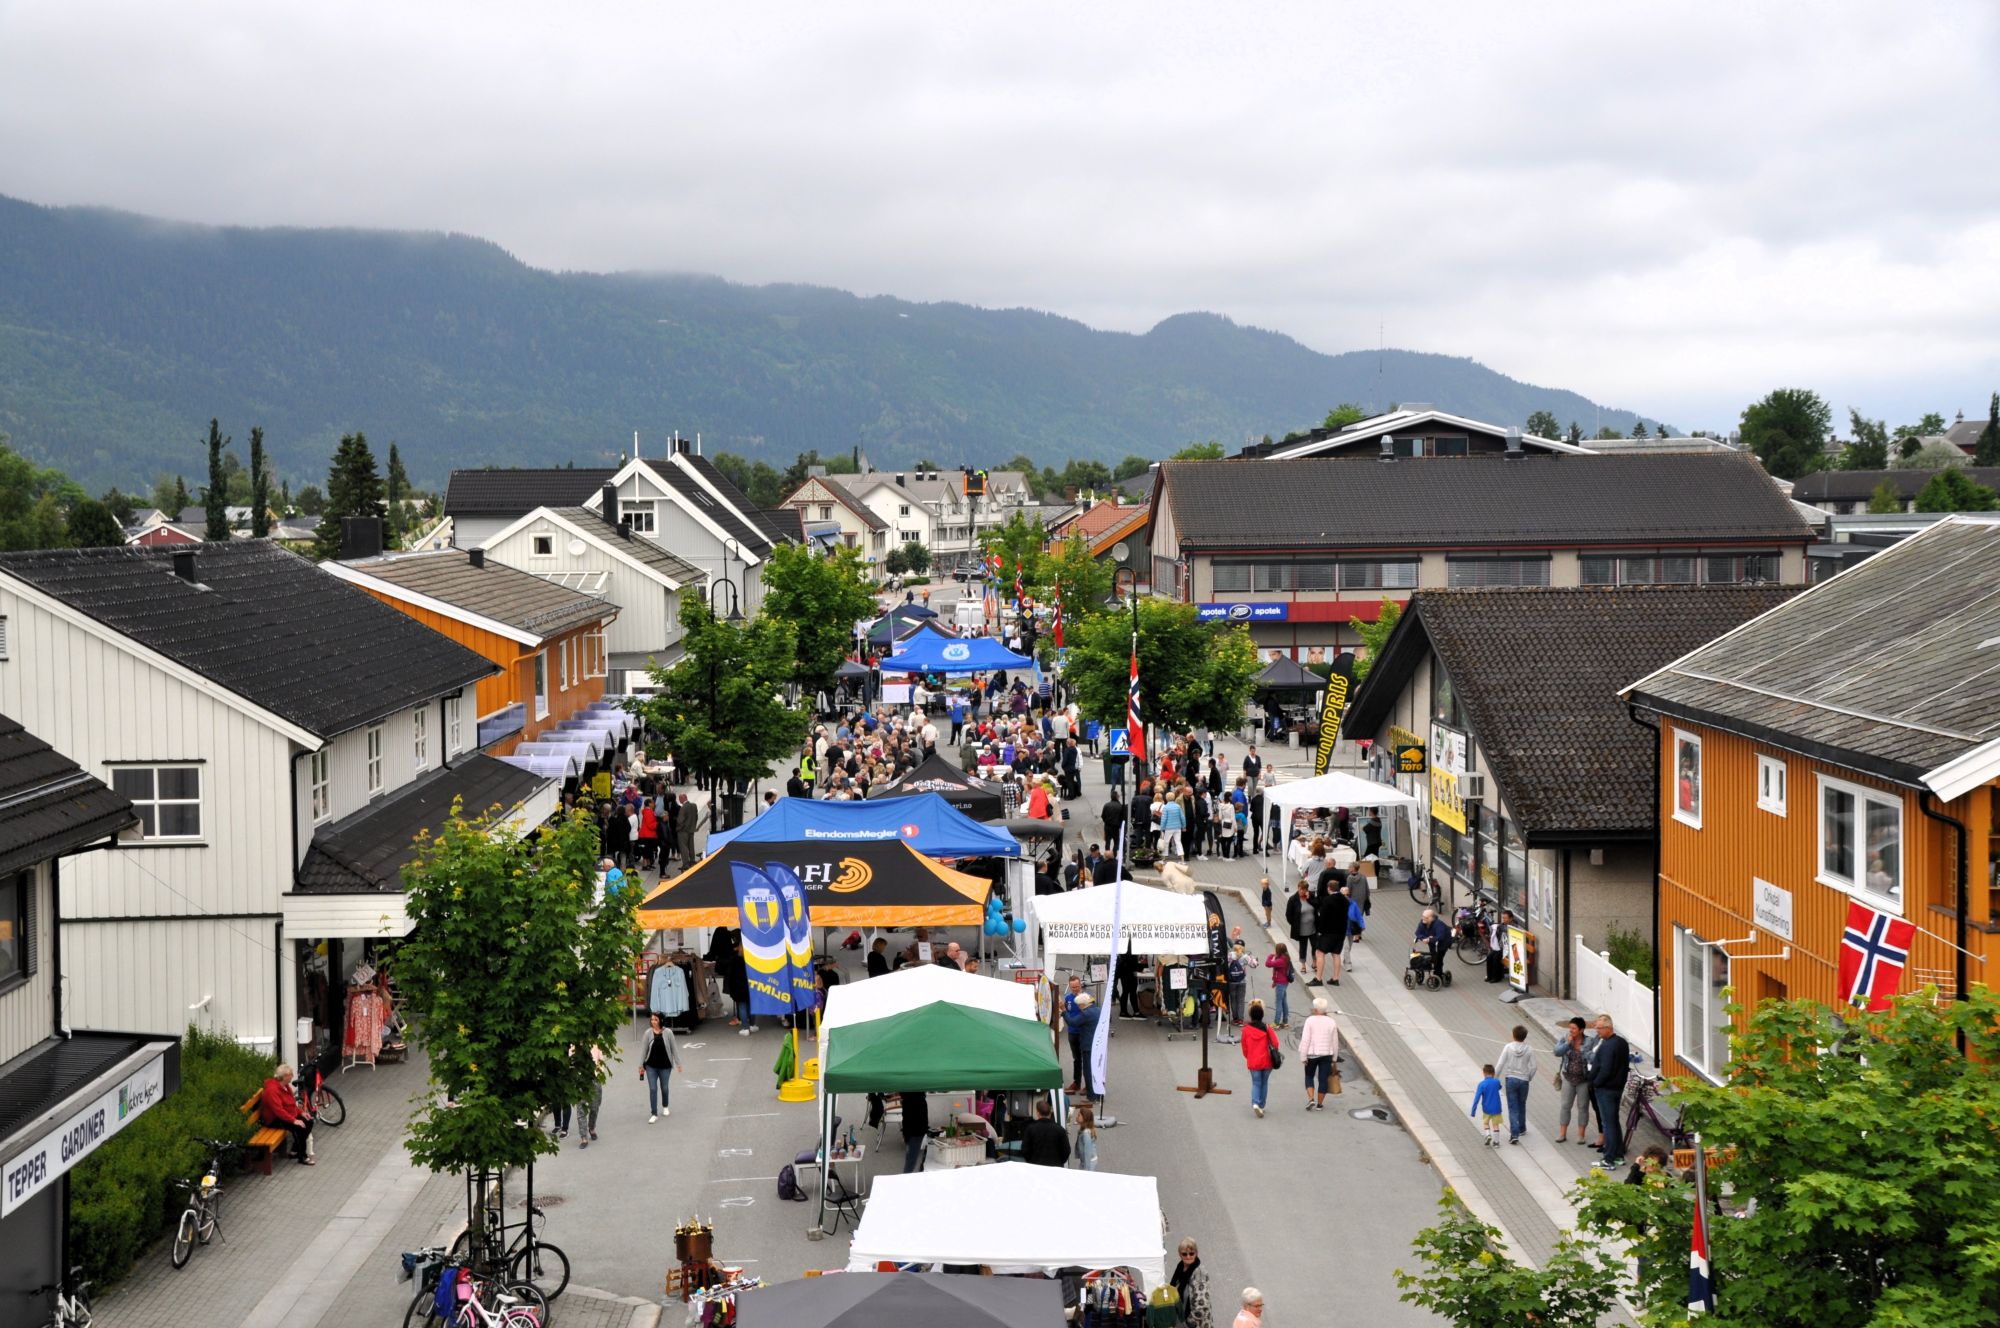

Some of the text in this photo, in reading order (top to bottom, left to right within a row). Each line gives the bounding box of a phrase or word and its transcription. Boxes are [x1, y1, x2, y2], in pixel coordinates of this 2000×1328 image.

[1200, 607, 1227, 617] apotek
[1254, 606, 1281, 616] apotek
[1400, 763, 1423, 771] TOTO
[804, 828, 898, 840] EiendomsMegler
[1048, 923, 1069, 931] VERO
[1090, 924, 1111, 932] VERO
[1132, 924, 1153, 932] VERO
[1154, 924, 1175, 932] VERO
[1174, 924, 1196, 932] VERO
[1090, 931, 1111, 939] MODA
[1132, 931, 1153, 939] MODA
[1154, 931, 1176, 939] MODA
[61, 1107, 105, 1164] GARDINER
[8, 1150, 47, 1203] TEPPER
